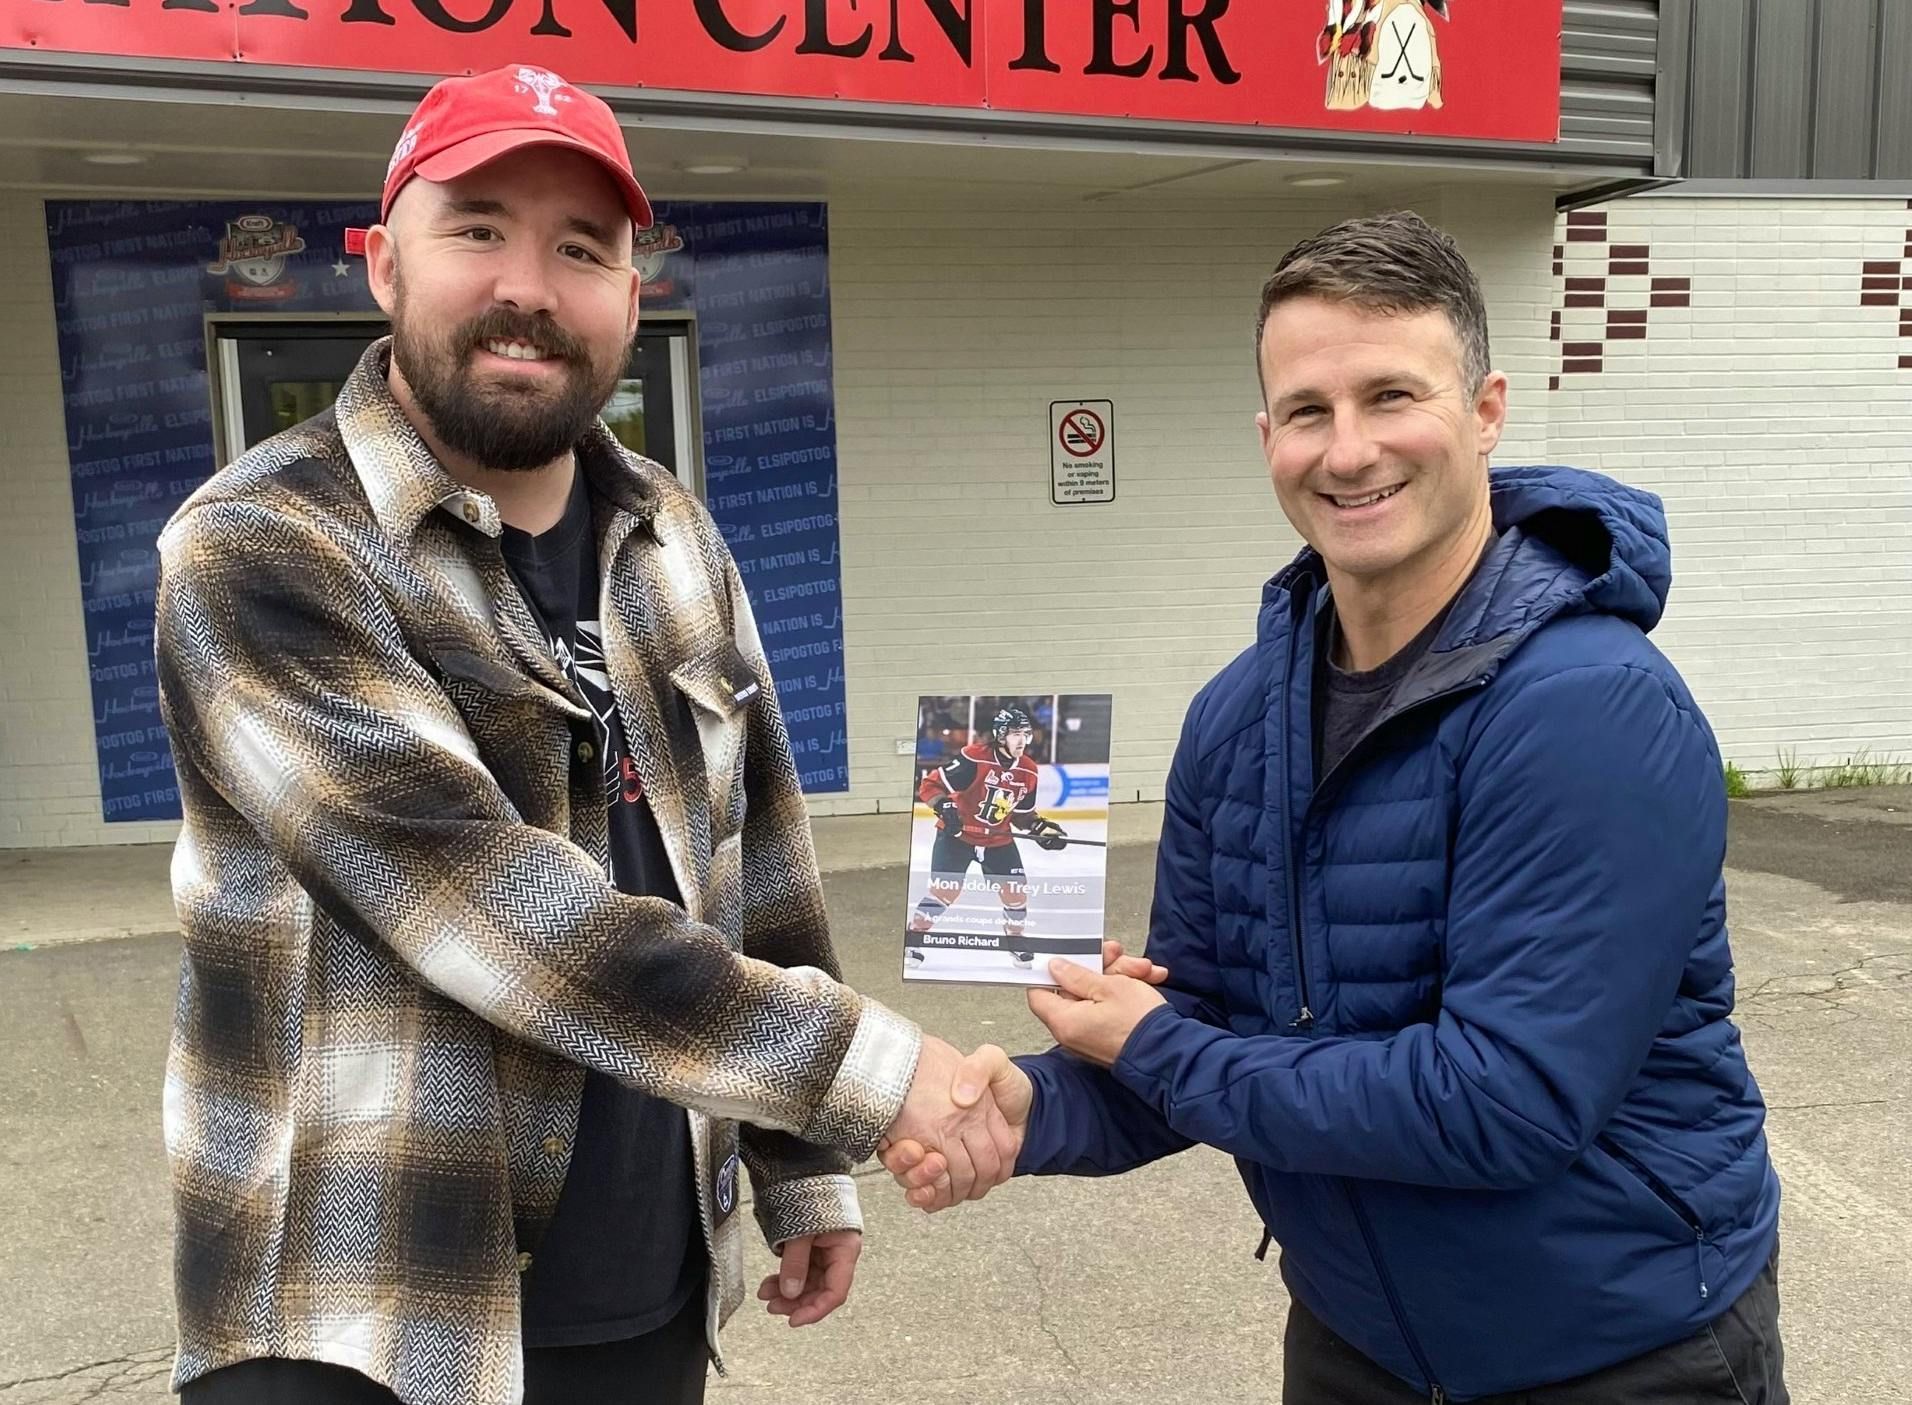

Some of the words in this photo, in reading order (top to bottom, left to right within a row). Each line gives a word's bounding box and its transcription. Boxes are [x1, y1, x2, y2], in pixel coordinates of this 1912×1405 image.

[748, 282, 796, 304] NATION
[752, 314, 828, 338] ELSIPOGTOG
[713, 359, 748, 379] FIRST
[751, 351, 798, 372] NATION
[800, 349, 814, 366] IS
[116, 381, 155, 401] FIRST
[754, 379, 828, 403] ELSIPOGTOG
[715, 424, 752, 443] FIRST
[753, 417, 800, 437] NATION
[801, 414, 816, 429] IS
[123, 451, 161, 473] FIRST
[757, 446, 832, 470] ELSIPOGTOG
[1074, 461, 1103, 469] smoking
[1077, 470, 1099, 478] vaping
[718, 491, 753, 511] FIRST
[757, 483, 803, 503] NATION
[805, 480, 818, 496] IS
[1073, 488, 1103, 496] premises
[761, 513, 834, 538] ELSIPOGTOG
[760, 550, 806, 572] NATION
[808, 547, 821, 563] IS
[764, 578, 837, 603] ELSIPOGTOG
[763, 615, 809, 635] NATION
[810, 612, 823, 627] IS
[804, 674, 817, 689] IS
[807, 737, 819, 752] IS
[623, 757, 643, 803] 5
[927, 878, 959, 891] Mon
[1007, 881, 1038, 896] Trey
[1044, 882, 1086, 895] Lewis
[966, 916, 993, 926] coups
[923, 934, 956, 946] Bruno
[958, 935, 1000, 947] Richard
